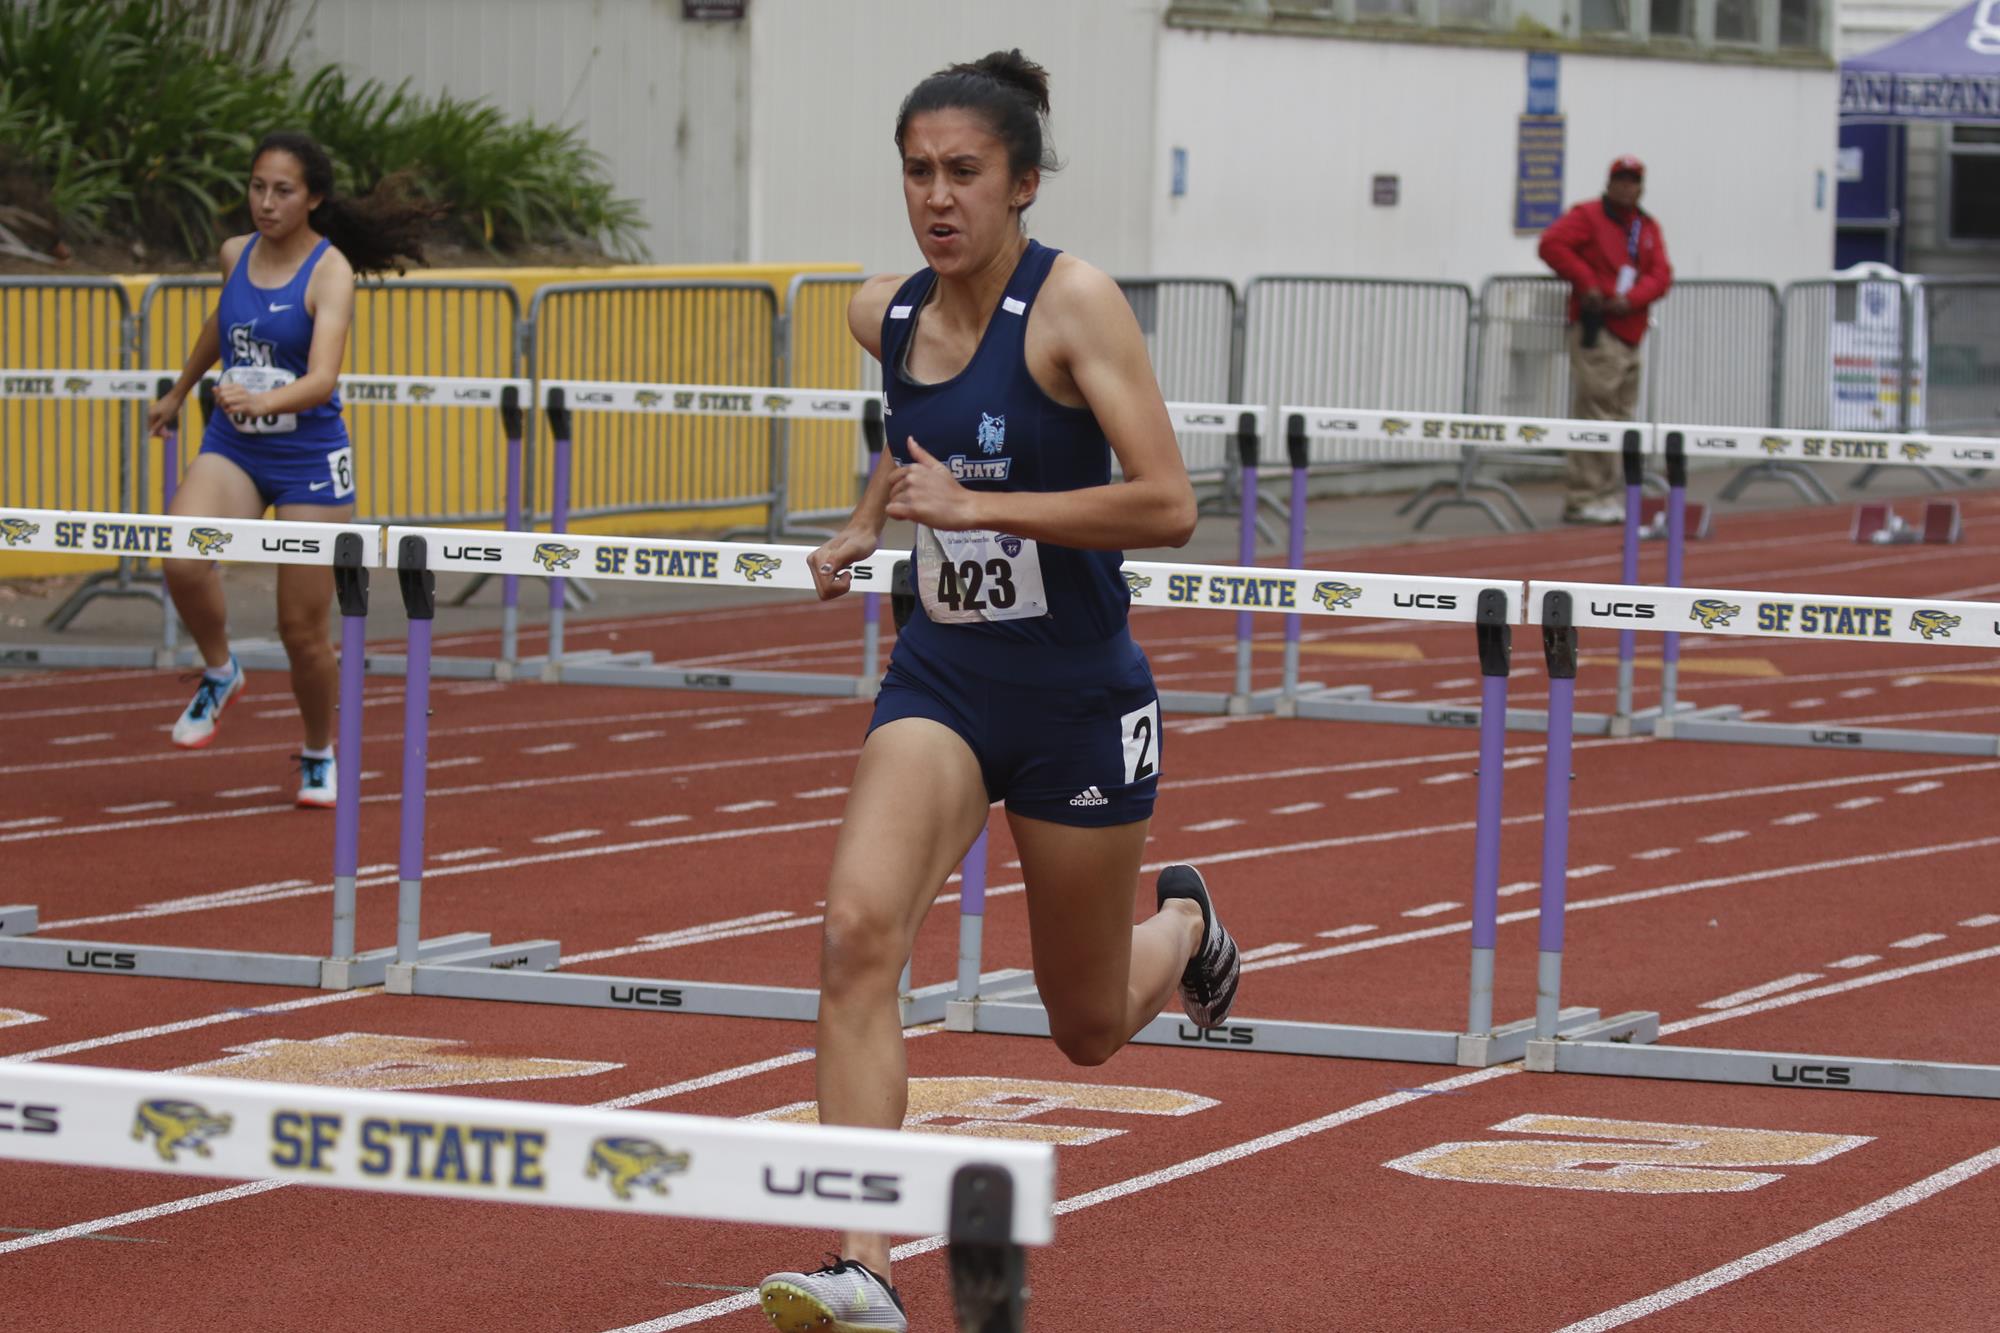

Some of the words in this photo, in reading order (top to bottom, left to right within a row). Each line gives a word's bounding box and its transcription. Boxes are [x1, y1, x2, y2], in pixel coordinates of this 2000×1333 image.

[4, 376, 54, 394] STATE
[346, 383, 397, 400] STATE
[674, 391, 694, 410] SF
[698, 393, 752, 412] STATE
[812, 401, 850, 411] UCS
[1184, 415, 1225, 425] UCS
[1317, 420, 1358, 430] UCS
[1424, 420, 1444, 438] SF
[1449, 422, 1505, 441] STATE
[1568, 432, 1610, 443] UCS
[1697, 437, 1737, 448] UCS
[1803, 438, 1824, 456] SF
[1830, 439, 1887, 459] STATE
[1954, 449, 1994, 460] UCS
[337, 455, 350, 489] 6
[951, 458, 1008, 478] STATE
[55, 521, 87, 548] SF
[92, 523, 173, 552] STATE
[262, 538, 320, 553] UCS
[443, 546, 502, 561] UCS
[595, 546, 629, 574] SF
[635, 549, 718, 578] STATE
[938, 558, 1016, 611] 423
[1168, 574, 1202, 602] SF
[1208, 576, 1297, 607] STATE
[1394, 593, 1456, 609] UCS
[1591, 602, 1655, 619] UCS
[1757, 603, 1795, 632] SF
[1800, 604, 1893, 637] STATE
[684, 673, 732, 686] UCS
[1428, 710, 1478, 724] UCS
[1812, 730, 1862, 745] UCS
[1133, 715, 1153, 781] 2
[1069, 797, 1109, 806] adidas
[67, 950, 136, 969] UCS
[610, 986, 682, 1006] UCS
[1179, 1024, 1254, 1044] UCS
[1772, 1064, 1850, 1084] UCS
[271, 1109, 342, 1172] SF
[359, 1117, 547, 1190] STATE
[763, 1166, 904, 1203] UCS
